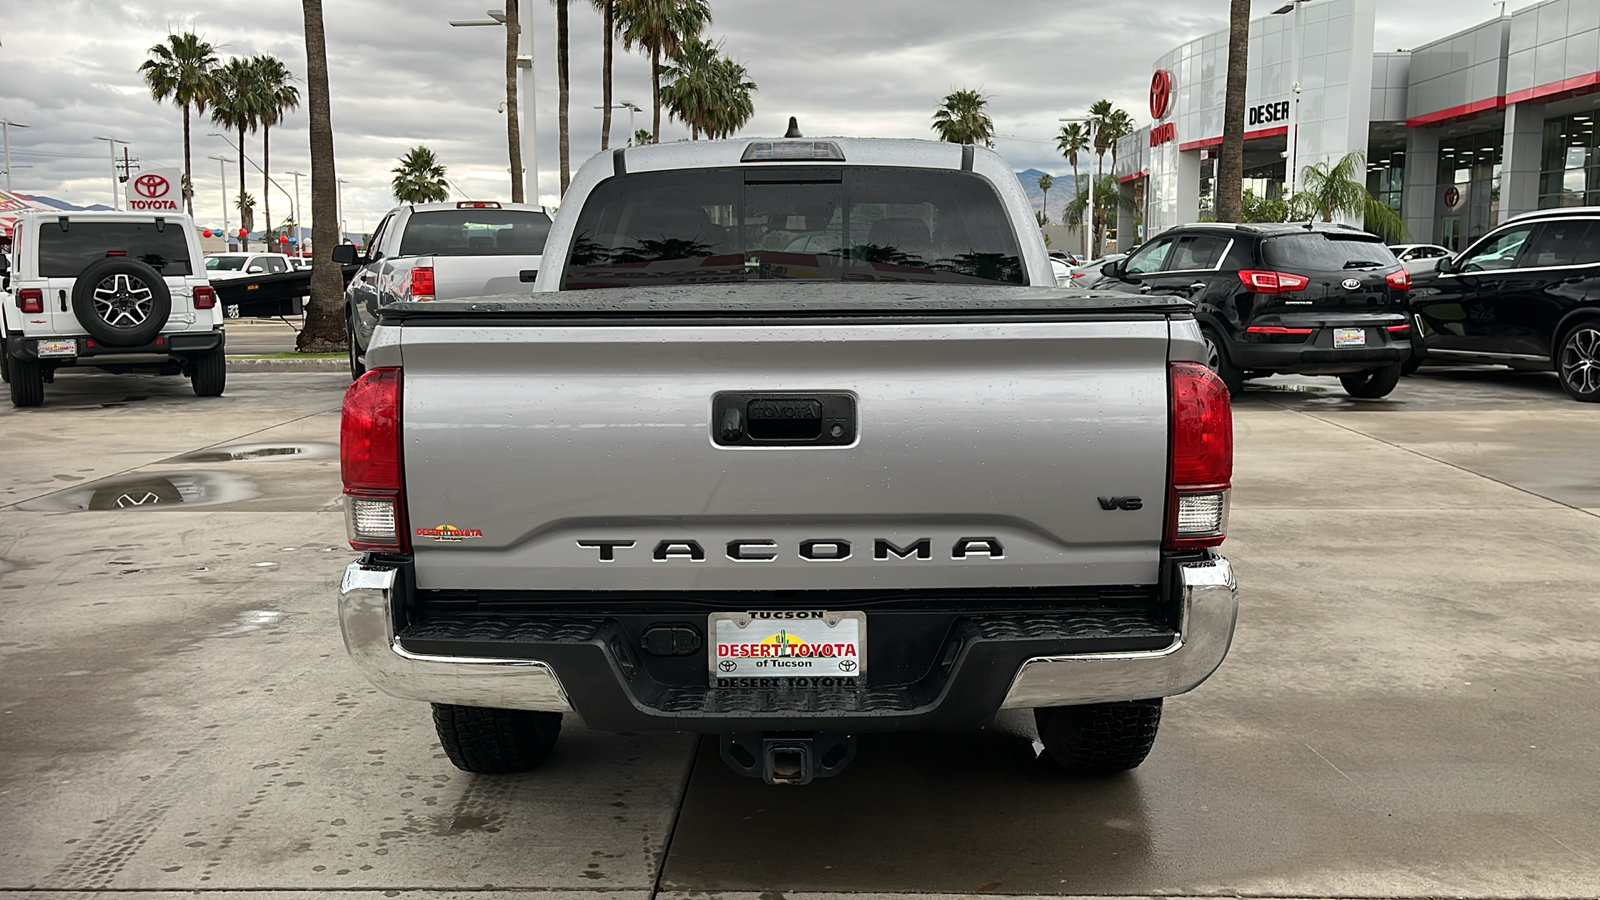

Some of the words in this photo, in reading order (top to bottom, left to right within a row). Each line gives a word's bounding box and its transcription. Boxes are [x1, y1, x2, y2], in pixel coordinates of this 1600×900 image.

[1249, 101, 1290, 125] DESER
[129, 200, 178, 210] TOYOTA
[754, 405, 816, 418] TOYOTA
[1097, 495, 1143, 511] V6
[449, 529, 483, 537] TOYOTA
[575, 536, 1006, 563] TACOMA
[749, 611, 824, 619] TUCSON
[718, 643, 781, 657] DESERT
[790, 643, 856, 657] TOYOTA
[771, 659, 812, 668] Tucson
[717, 678, 780, 688] DESERT
[788, 677, 856, 687] TOYOTA
